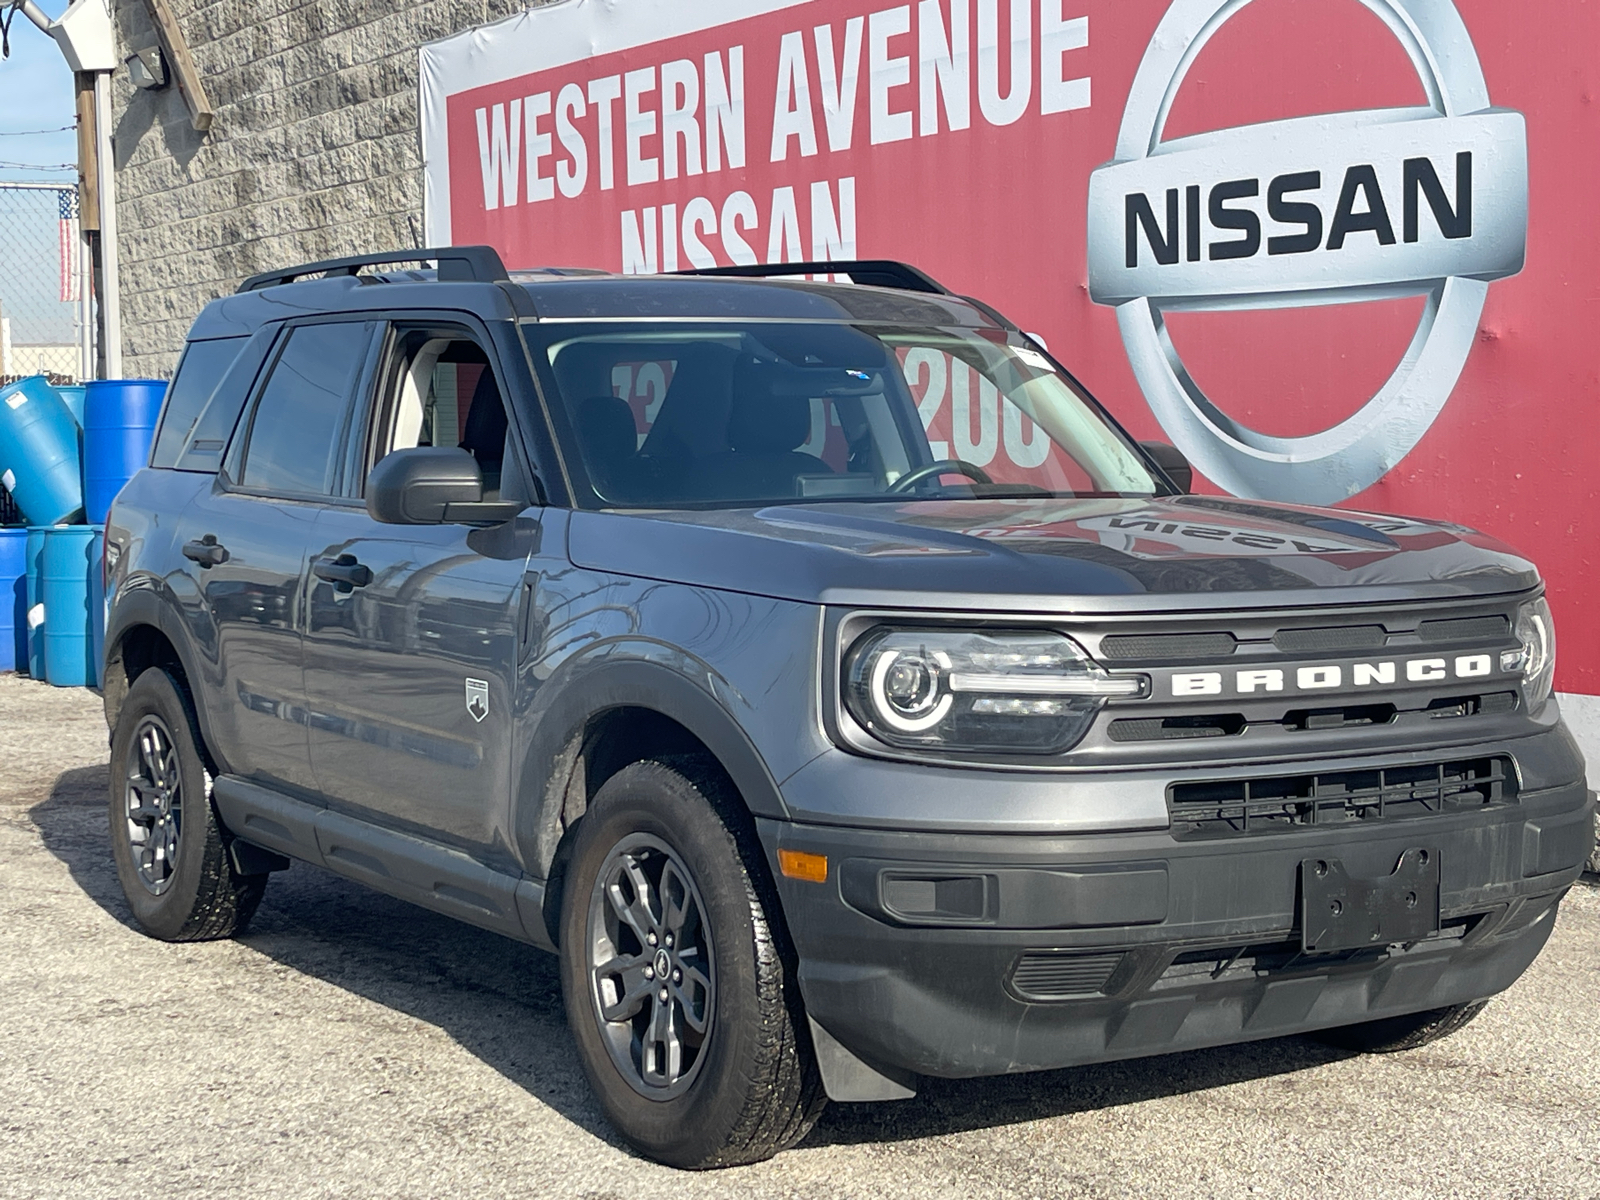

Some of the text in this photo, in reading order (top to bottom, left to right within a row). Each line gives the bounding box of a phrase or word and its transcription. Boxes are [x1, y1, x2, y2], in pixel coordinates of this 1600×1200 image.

[475, 0, 1091, 211] WESTERN AVENUE
[621, 180, 857, 284] NISSAN
[1125, 151, 1472, 268] NISSAN
[1171, 654, 1491, 696] BRONCO
